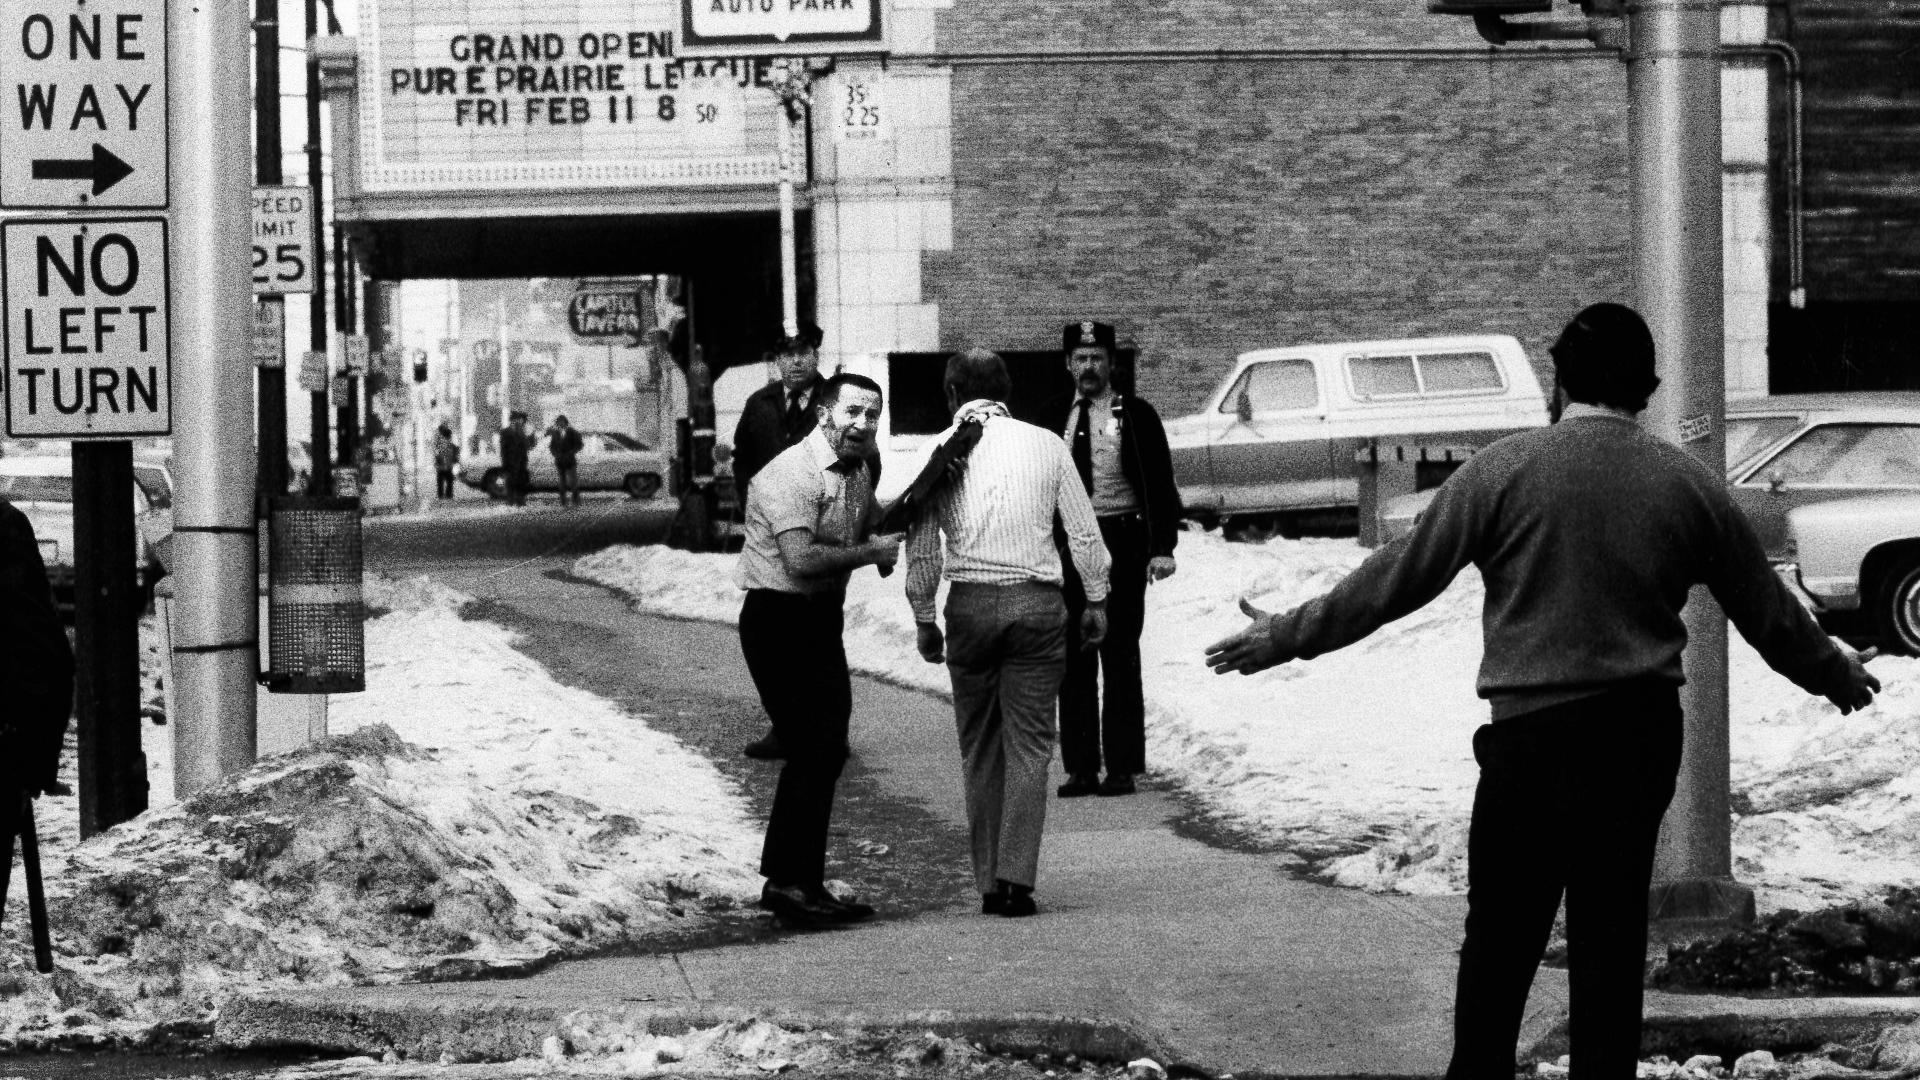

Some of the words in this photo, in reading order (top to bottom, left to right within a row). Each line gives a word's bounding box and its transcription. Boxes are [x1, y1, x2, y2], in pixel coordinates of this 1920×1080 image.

[22, 13, 146, 61] ONE
[451, 33, 565, 62] GRAND
[579, 32, 673, 59] OPENI
[391, 66, 487, 95] PURE
[496, 64, 625, 93] PRAIRIE
[17, 83, 152, 131] WAY
[456, 98, 508, 126] FRI
[526, 97, 591, 124] FEB
[609, 95, 634, 123] 11
[657, 94, 677, 121] 8
[256, 221, 296, 236] IMIT
[36, 233, 140, 297] NO
[253, 244, 305, 283] 25
[24, 306, 157, 355] LEFT
[17, 366, 158, 415] TURN
